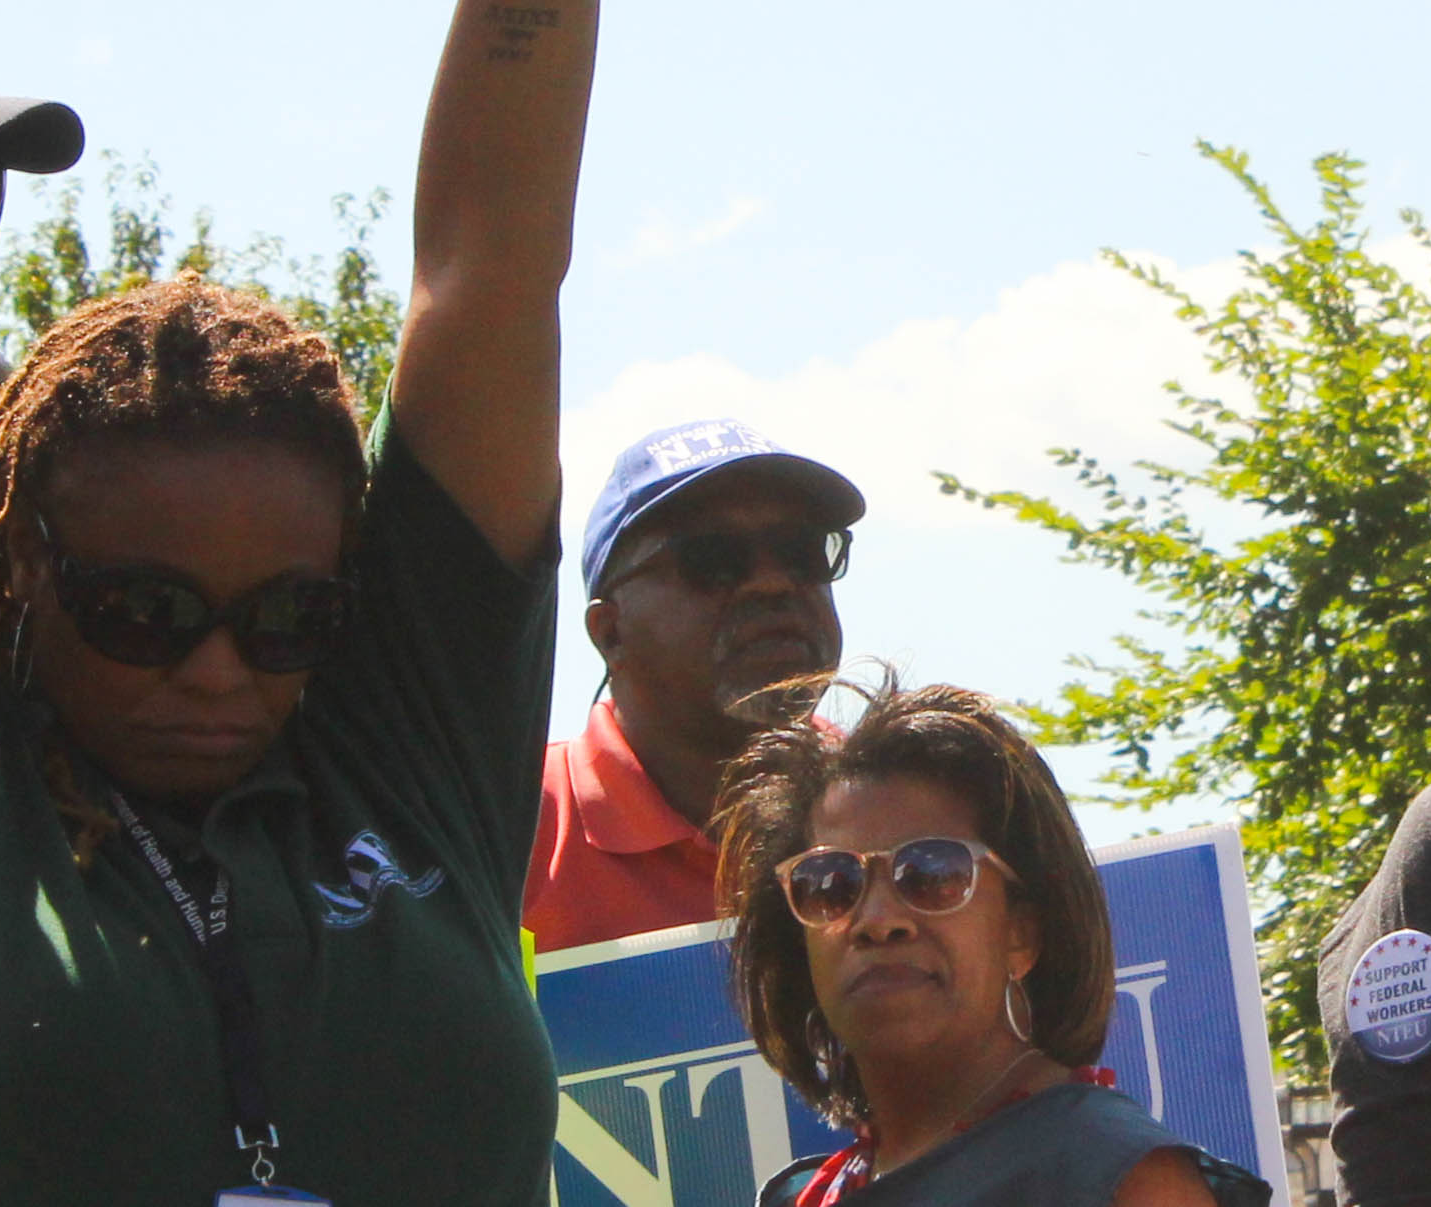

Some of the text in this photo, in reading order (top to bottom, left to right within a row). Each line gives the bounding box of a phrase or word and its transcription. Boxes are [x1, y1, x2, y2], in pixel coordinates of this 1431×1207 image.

[654, 424, 773, 476] NTE
[139, 835, 173, 879] Health
[164, 877, 192, 903] and
[179, 899, 207, 944] Huma
[1364, 957, 1429, 986] SUPPORT
[1368, 977, 1428, 1005] FEDERAL
[1375, 1017, 1429, 1048] NTEU
